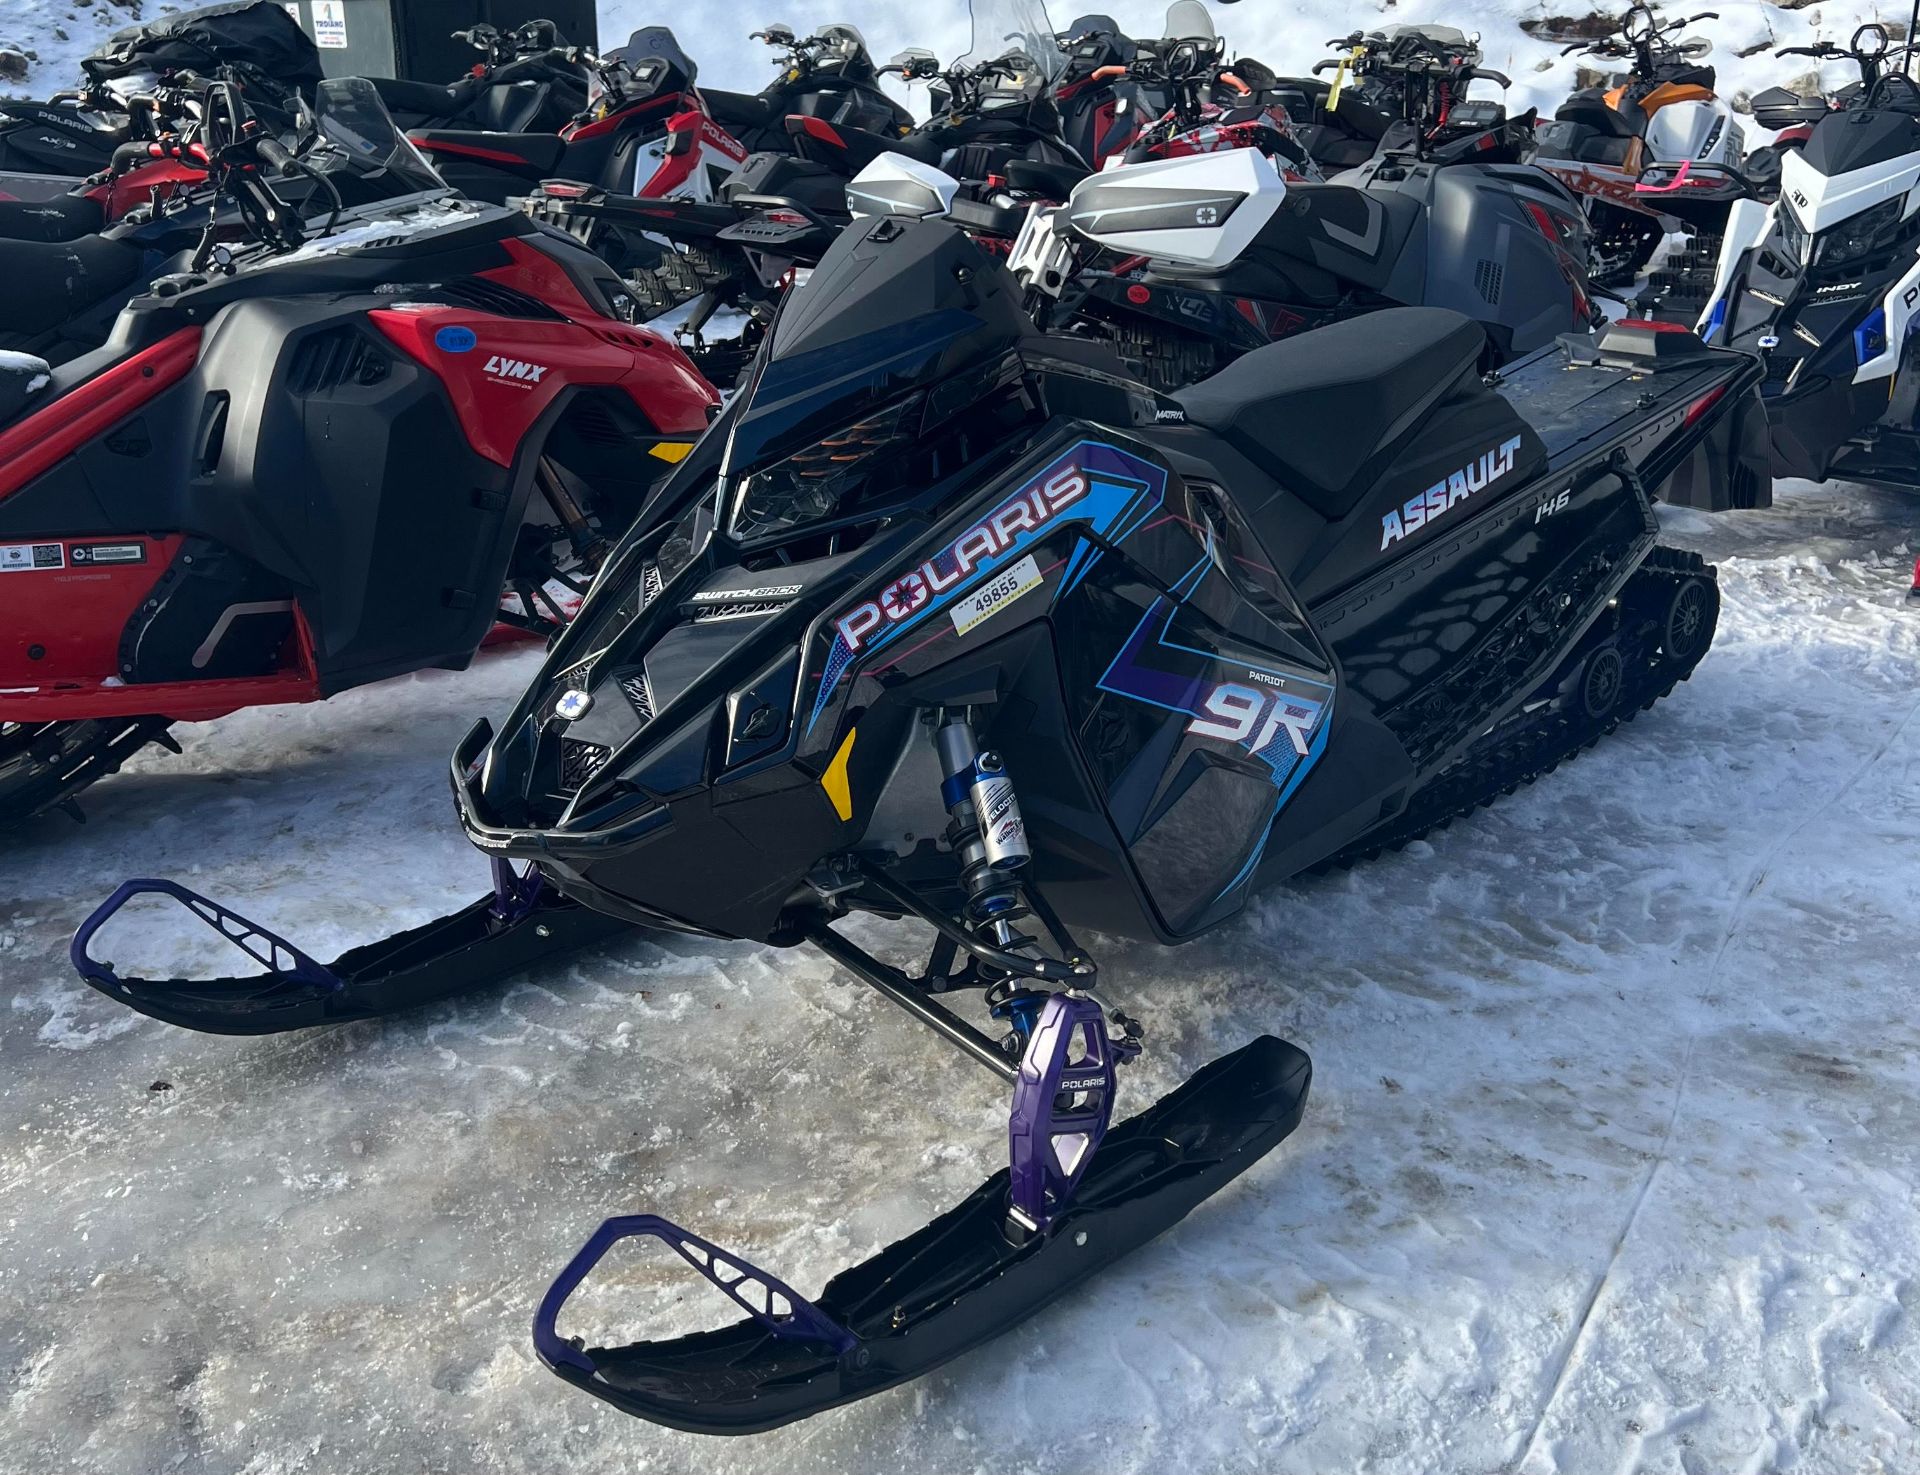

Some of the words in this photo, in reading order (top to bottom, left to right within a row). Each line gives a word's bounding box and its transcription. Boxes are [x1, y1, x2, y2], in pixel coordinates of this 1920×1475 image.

[38, 111, 93, 133] POLARIS
[702, 121, 743, 158] POLARIS
[1816, 282, 1862, 294] INDY
[483, 355, 548, 383] LYNX
[1380, 434, 1521, 551] ASSAULT
[1534, 488, 1571, 525] 146
[836, 464, 1086, 651] POLARIS
[692, 584, 803, 601] SWITCHBACK
[975, 576, 1018, 612] 49855
[1248, 670, 1286, 688] PATRIOT
[1186, 682, 1311, 757] 9R
[1062, 1077, 1105, 1089] POLARIS
